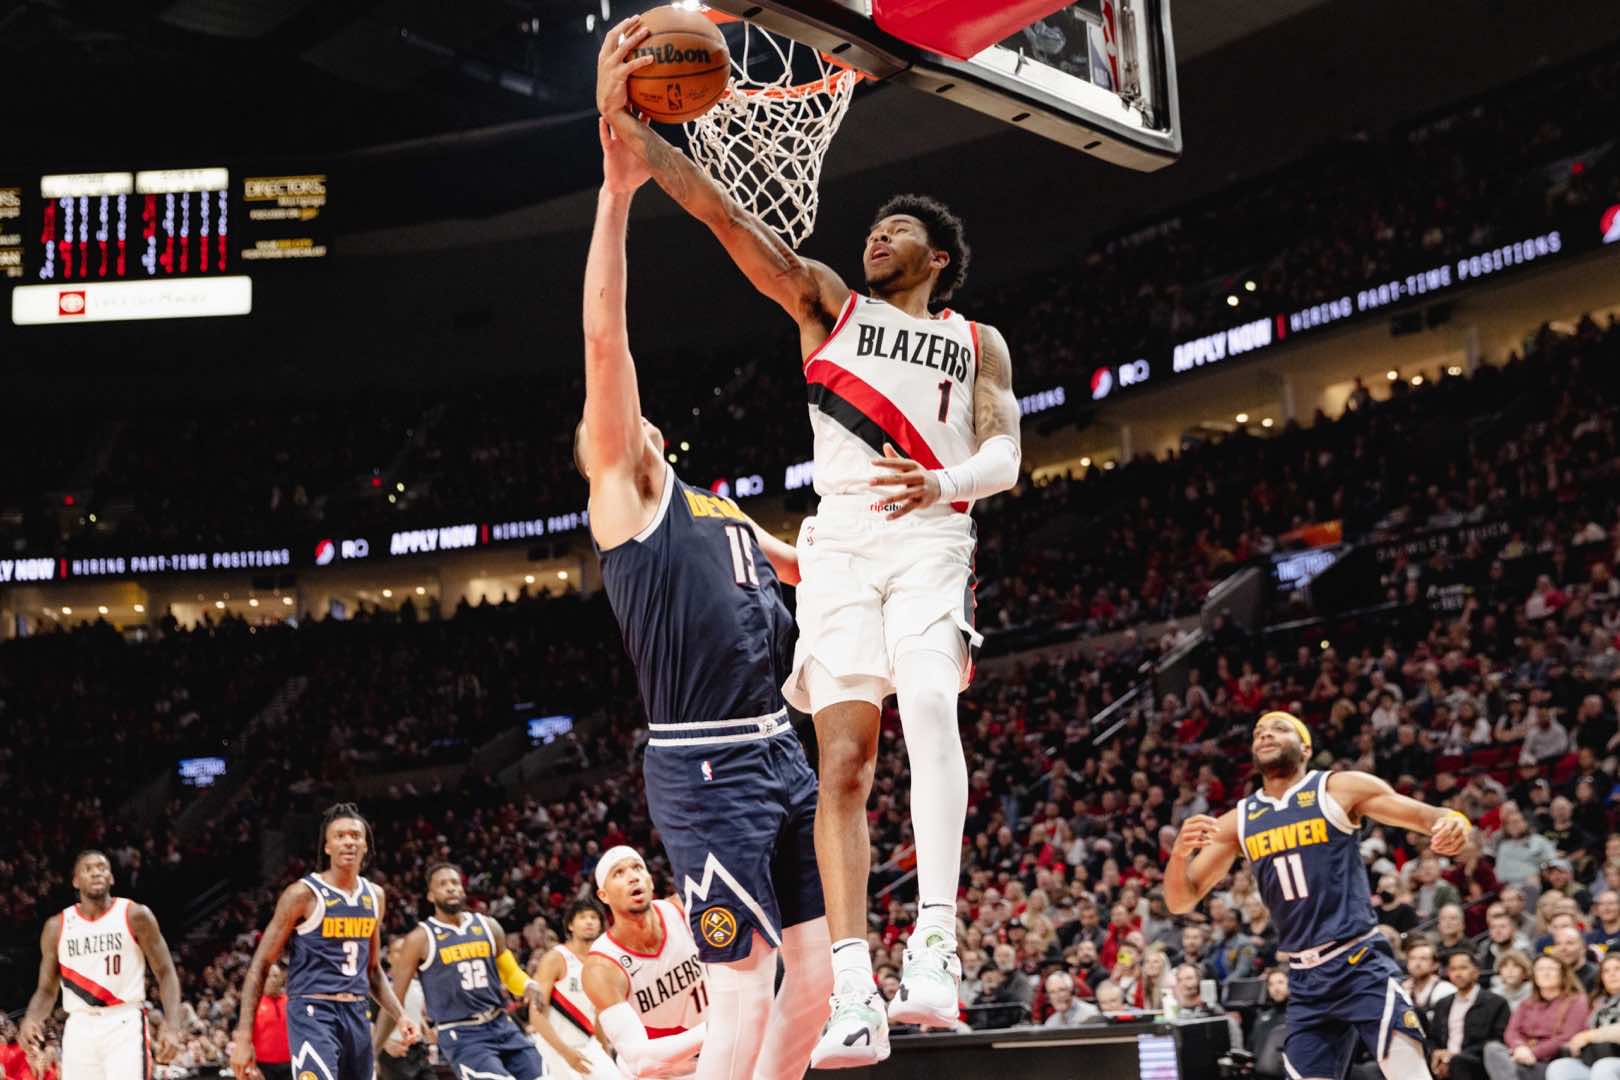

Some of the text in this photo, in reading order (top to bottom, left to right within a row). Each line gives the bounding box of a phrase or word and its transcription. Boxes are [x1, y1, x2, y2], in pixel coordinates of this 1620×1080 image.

[1173, 230, 1561, 373] APPLY NOW HIRING PART-TIME POSITIONS
[857, 323, 971, 383] BLAZERS
[938, 379, 952, 424] 1
[390, 530, 438, 555] APPLY
[438, 524, 477, 550] NOW
[492, 519, 541, 541] HIRING
[15, 558, 55, 582] NOW
[72, 557, 125, 576] HIRING
[131, 552, 207, 573] PART-TIME
[212, 548, 290, 569] POSITIONS
[1245, 818, 1329, 861] DENVER
[1273, 852, 1309, 901] 11
[66, 932, 122, 958] BLAZERS
[342, 940, 359, 976] 3
[439, 941, 490, 965] DENVER
[104, 954, 121, 975] 10
[457, 959, 489, 990] 32
[635, 954, 702, 1013] BLAZERS
[690, 980, 709, 1013] 11
